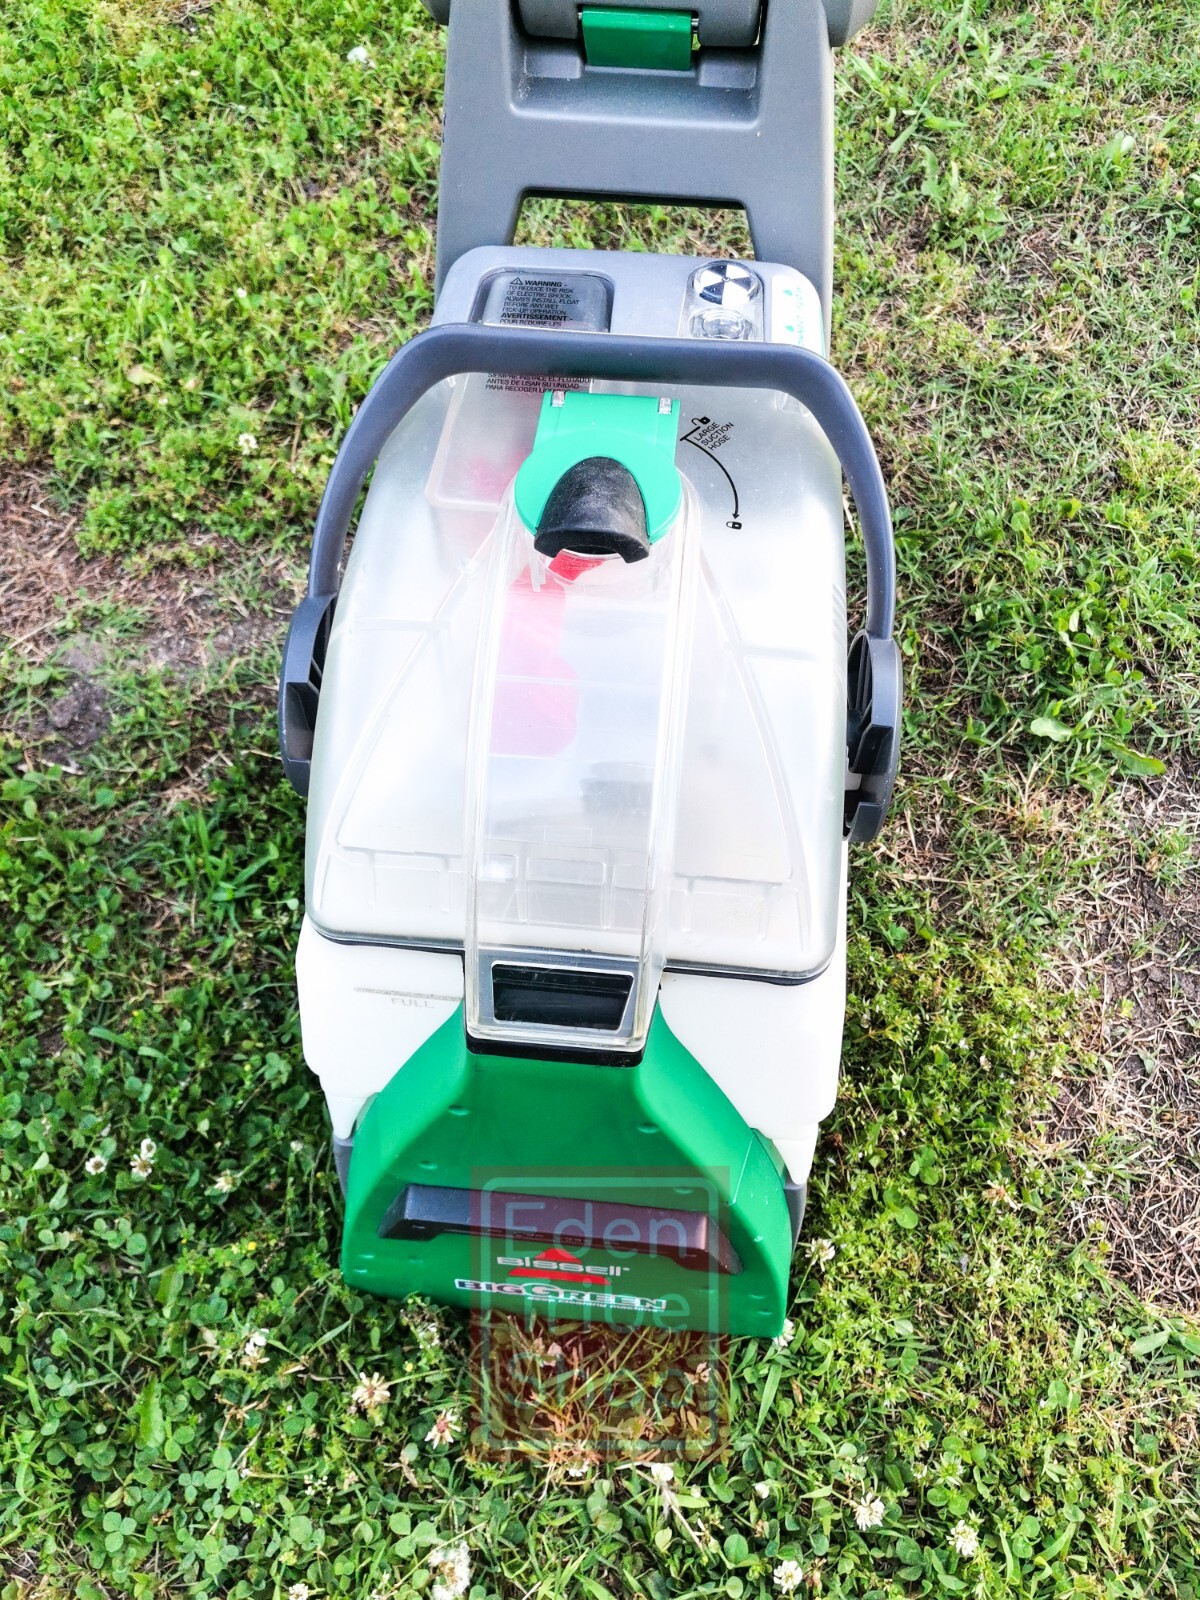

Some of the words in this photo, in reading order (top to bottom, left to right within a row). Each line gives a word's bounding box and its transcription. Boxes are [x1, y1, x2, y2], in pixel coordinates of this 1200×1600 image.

[500, 313, 568, 321] AVERTISSEMENT
[505, 385, 538, 393] RECOGER
[693, 422, 720, 442] LARGE
[701, 422, 734, 447] SUCTION
[708, 434, 731, 451] HOSE
[390, 997, 434, 1009] FULL
